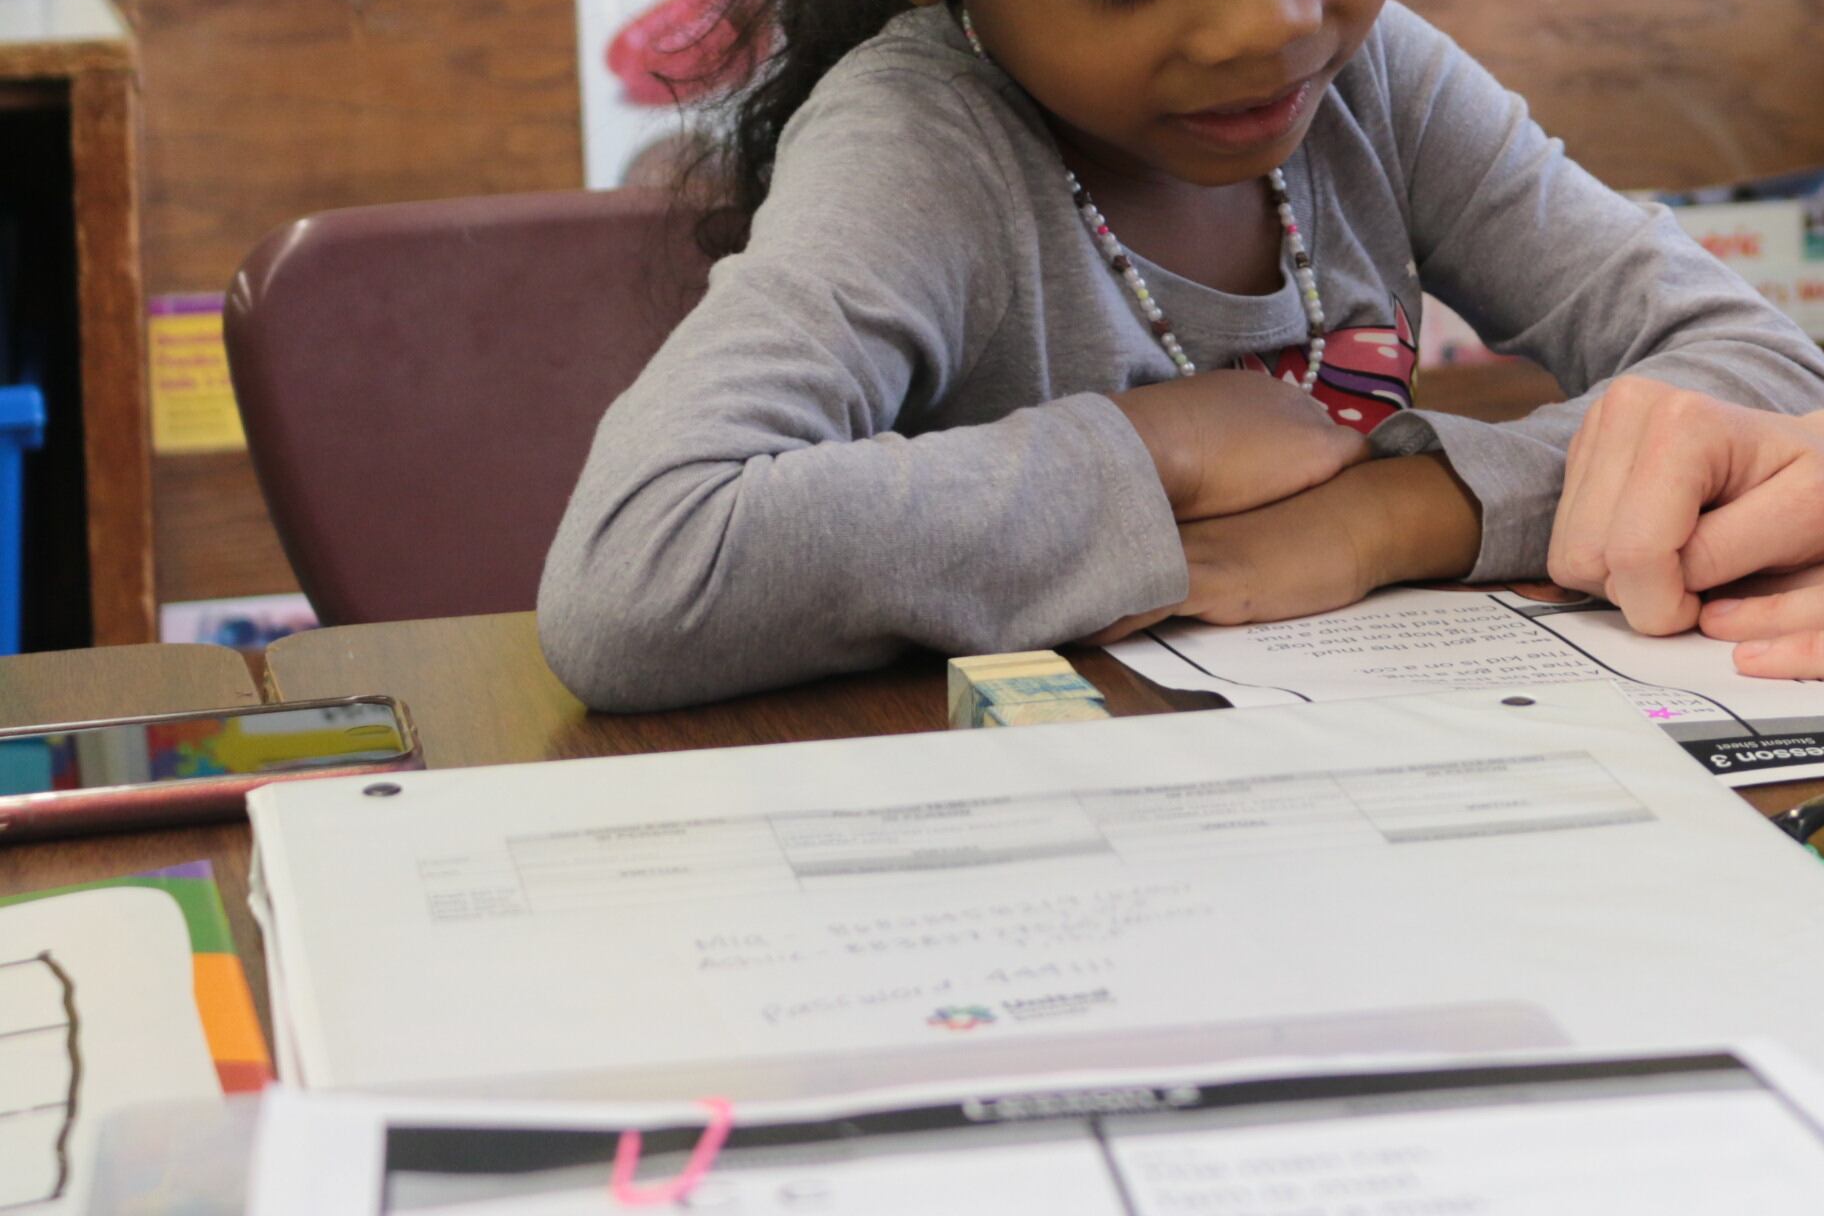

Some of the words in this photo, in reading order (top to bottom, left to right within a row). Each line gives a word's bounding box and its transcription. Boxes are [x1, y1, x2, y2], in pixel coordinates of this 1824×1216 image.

[1398, 609, 1428, 618] rat
[1453, 605, 1497, 613] Can
[1353, 612, 1391, 622] run
[1455, 613, 1512, 625] Mom
[1318, 618, 1348, 626] up
[1370, 622, 1406, 630] the
[1488, 621, 1527, 632] Did
[1319, 624, 1363, 636] pup
[1398, 629, 1443, 640] hop
[1319, 636, 1358, 645] the
[1363, 633, 1392, 641] on
[1442, 637, 1476, 646] got
[1371, 643, 1408, 651] the
[1461, 658, 1482, 667] is
[1486, 653, 1523, 665] kid
[1424, 661, 1454, 669] on
[1499, 663, 1536, 674] lad
[1715, 739, 1759, 751] Sheet
[1760, 736, 1817, 747] Student
[1709, 754, 1733, 768] 3
